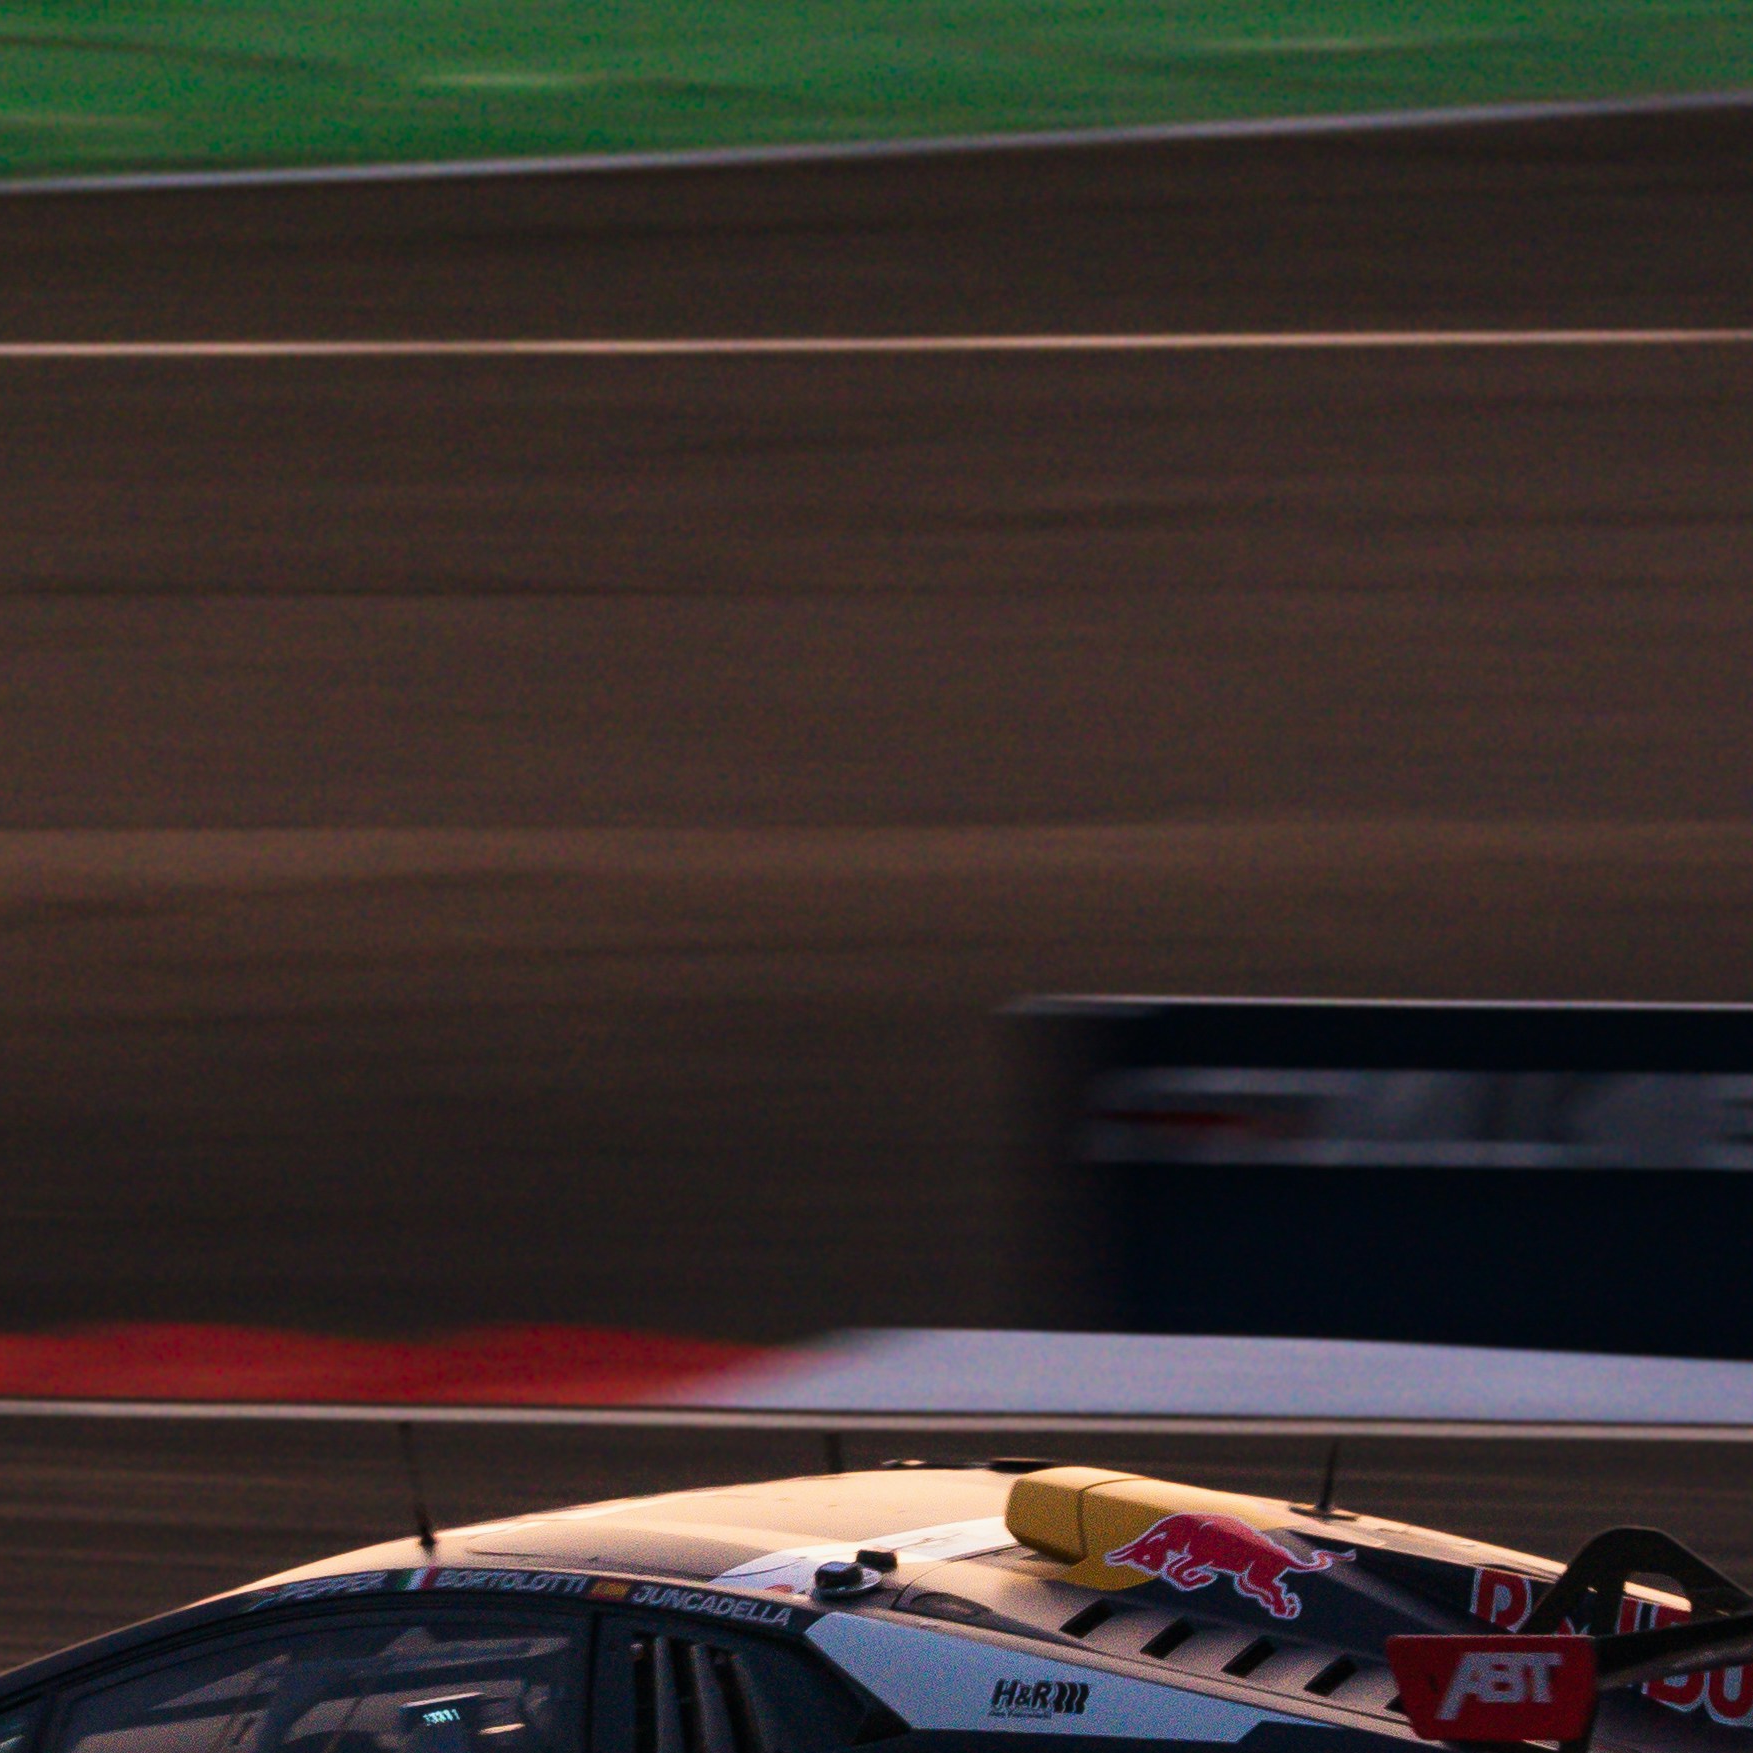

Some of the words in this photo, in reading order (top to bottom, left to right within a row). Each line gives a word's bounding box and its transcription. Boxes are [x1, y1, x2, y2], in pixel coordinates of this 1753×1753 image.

[434, 1570, 588, 1595] BORTOLOTTI
[632, 1585, 793, 1628] JUNCADELLA
[1435, 1651, 1564, 1720] ABT
